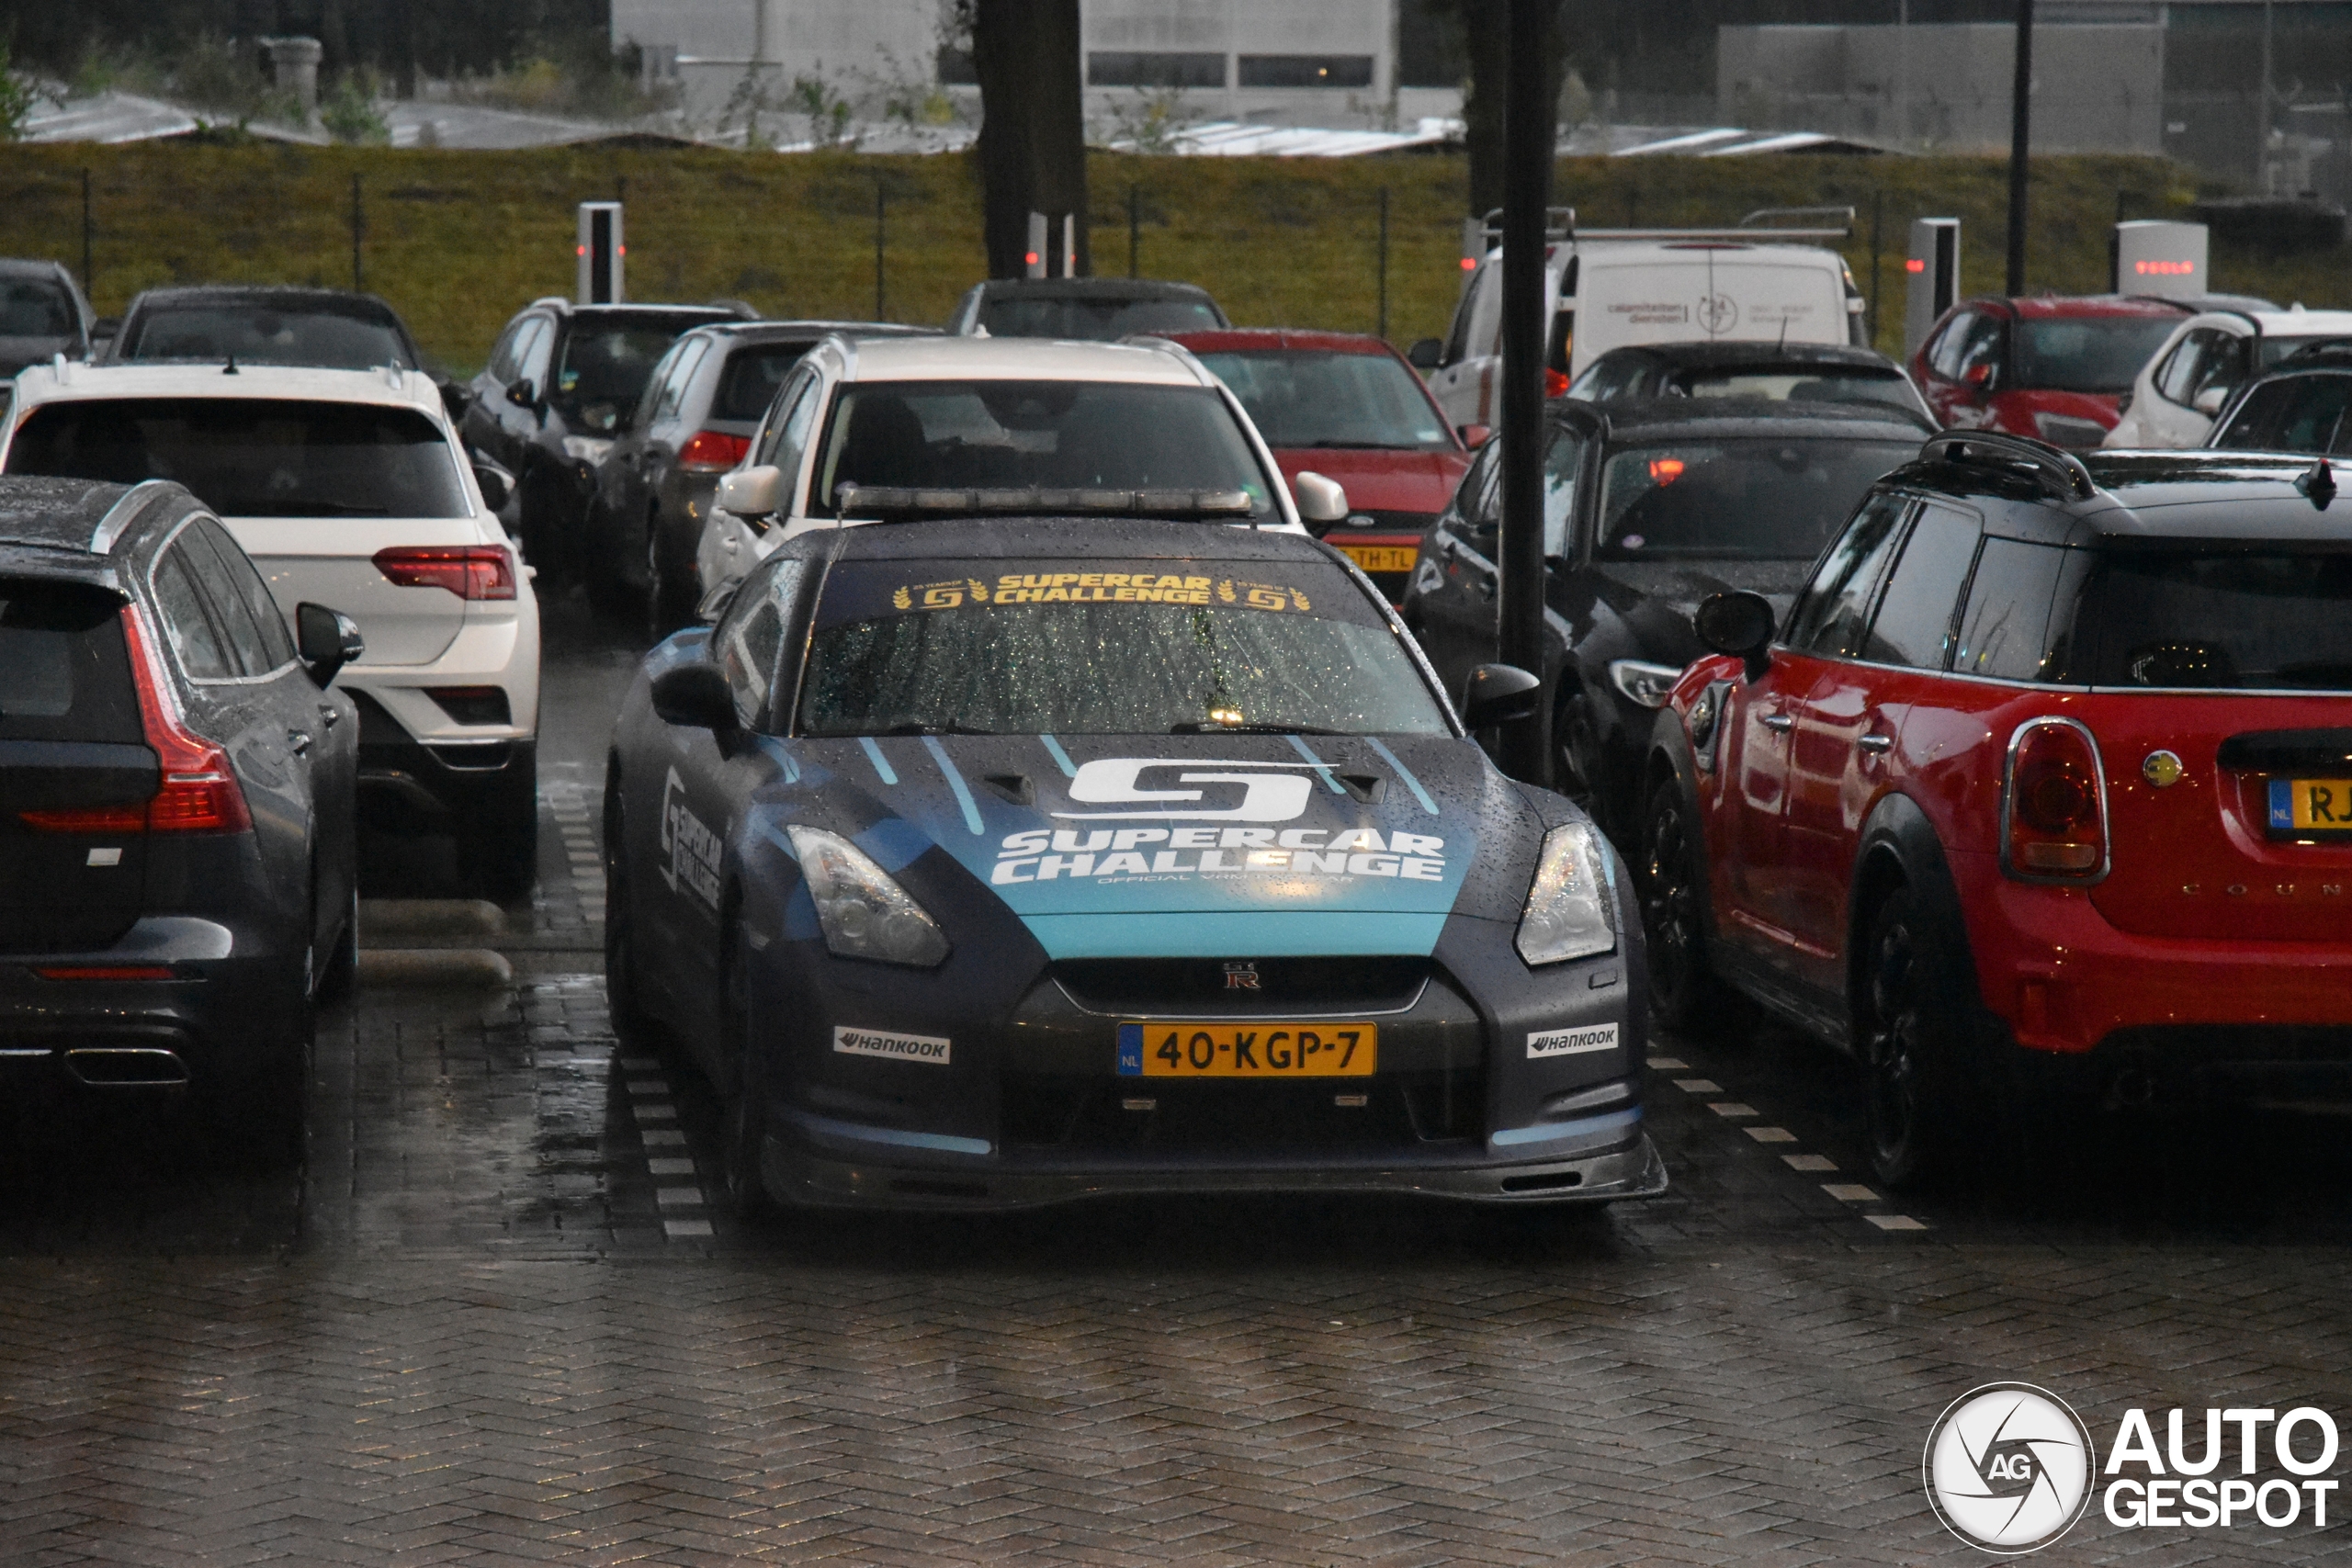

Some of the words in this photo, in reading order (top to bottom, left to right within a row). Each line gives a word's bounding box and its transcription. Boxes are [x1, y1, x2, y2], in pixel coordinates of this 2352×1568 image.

[998, 573, 1211, 590] SUPERCAR
[993, 587, 1209, 604] CHALLENGE
[2274, 809, 2290, 820] NL
[998, 828, 1445, 859] SUPERCAR
[990, 850, 1446, 886] CHALLENGE
[1097, 874, 1192, 885] OFFICIAL
[1122, 1055, 1139, 1067] NL
[1157, 1032, 1361, 1069] 40-KGP-7
